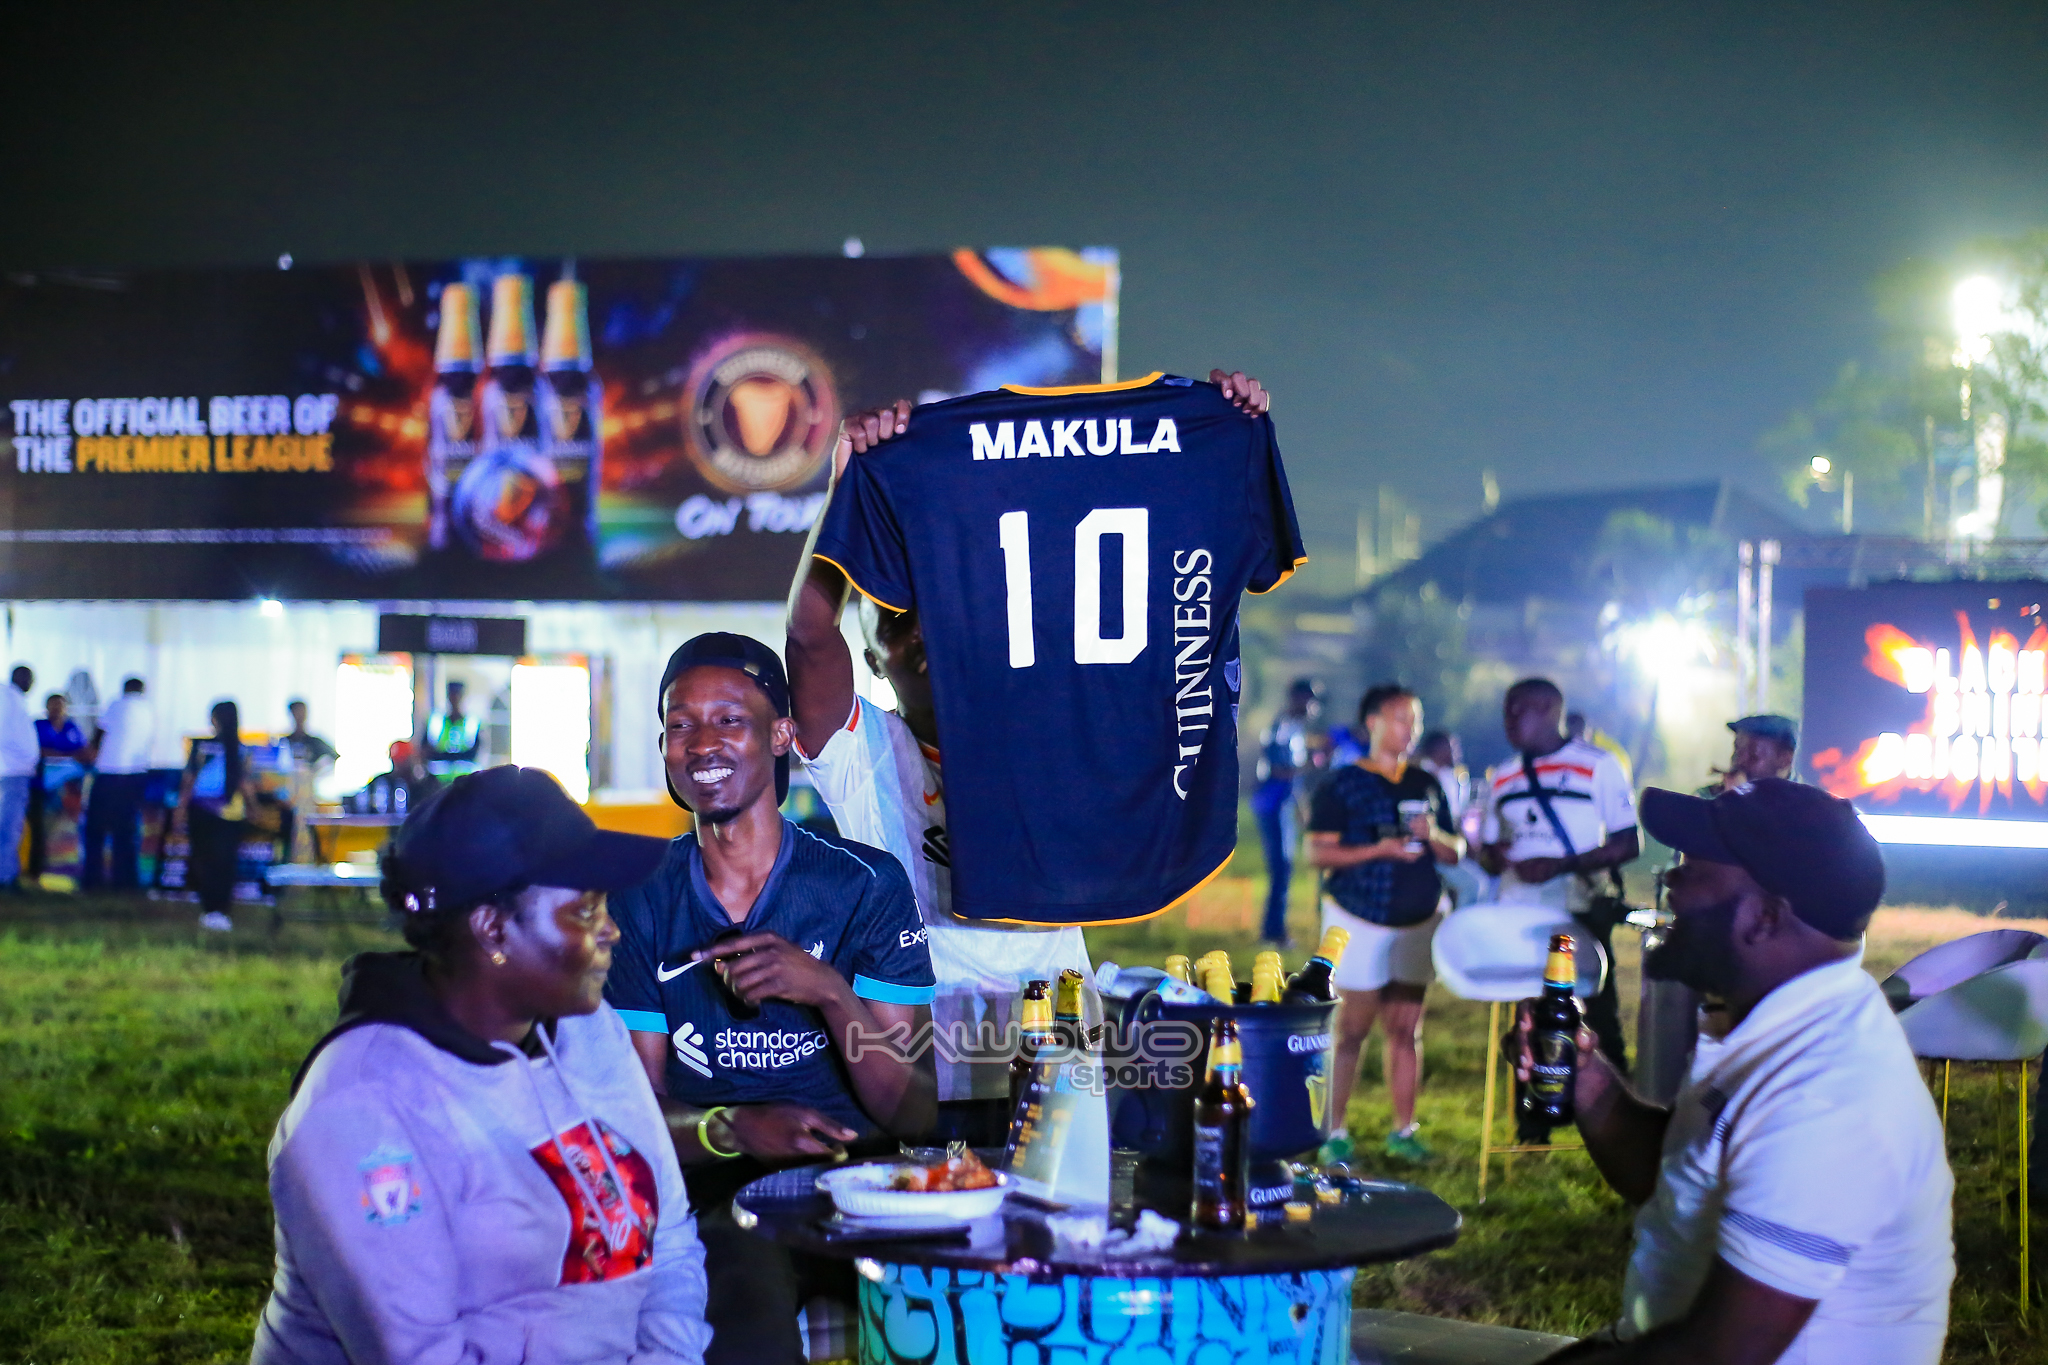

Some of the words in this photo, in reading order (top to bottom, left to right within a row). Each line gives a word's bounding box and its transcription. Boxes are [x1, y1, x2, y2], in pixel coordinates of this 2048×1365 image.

[9, 398, 71, 436] THE
[72, 397, 207, 437] OFFICIAL
[209, 394, 291, 436] BEER
[293, 393, 339, 436] OF
[12, 434, 73, 474] THE
[75, 434, 211, 473] PREMIER
[213, 433, 335, 473] LEAGUE
[969, 418, 1181, 460] MAKULA
[998, 507, 1149, 669] 10
[715, 1027, 818, 1049] standar
[717, 1028, 829, 1069] chartered
